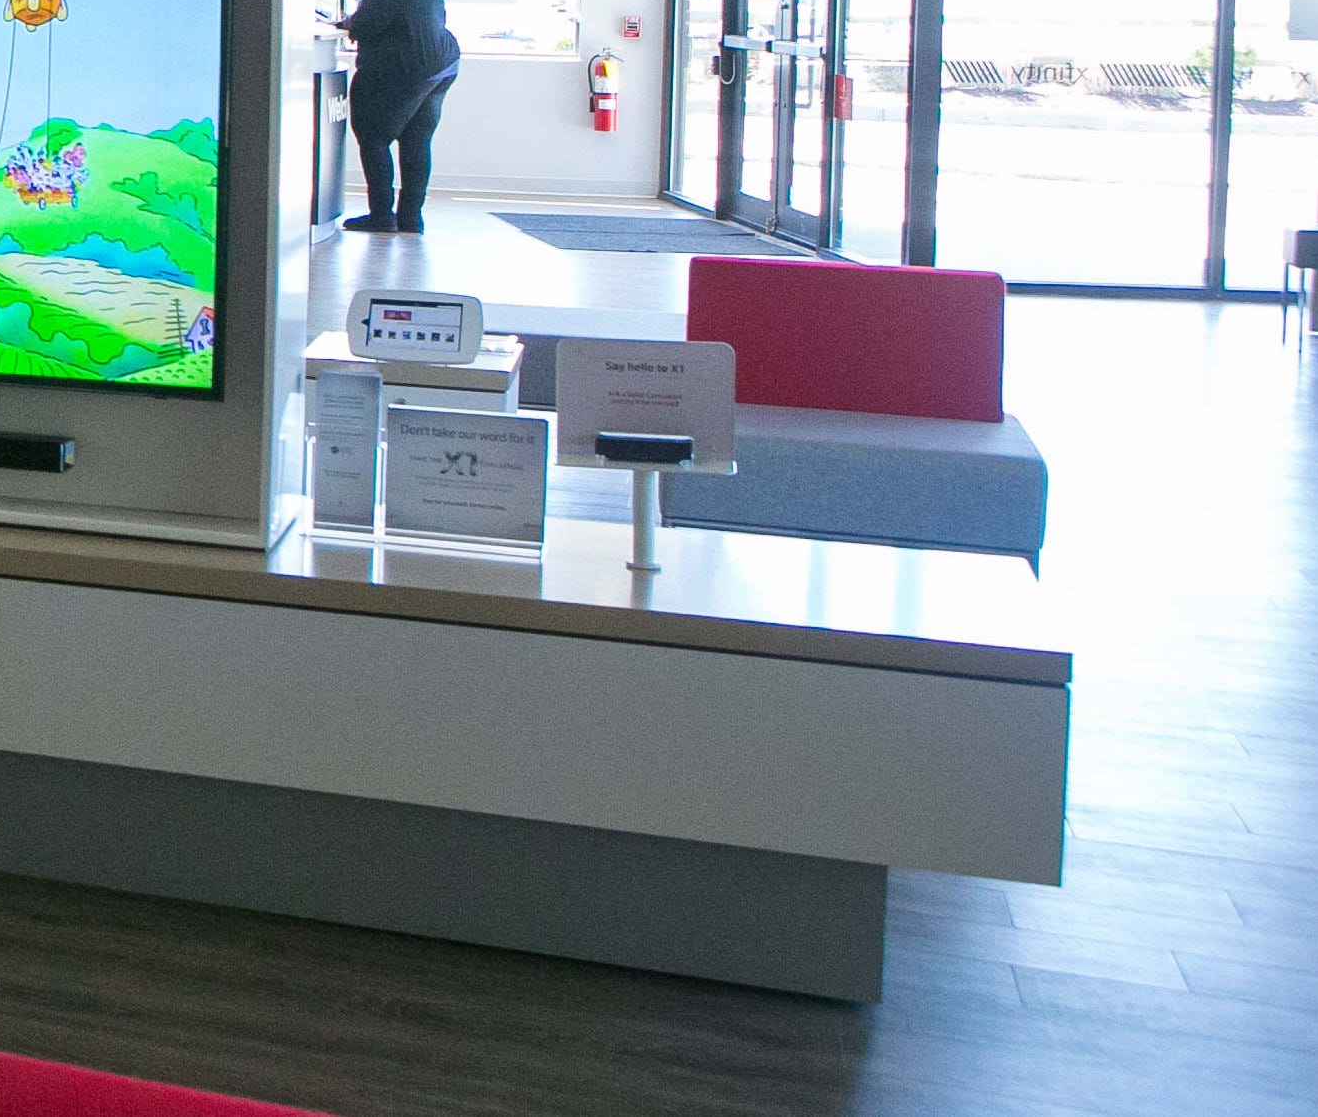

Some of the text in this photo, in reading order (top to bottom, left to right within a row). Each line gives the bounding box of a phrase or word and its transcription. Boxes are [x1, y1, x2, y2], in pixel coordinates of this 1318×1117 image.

[605, 362, 625, 373] Say
[627, 363, 654, 372] hello
[657, 364, 668, 373] to
[400, 423, 430, 436] Don't
[432, 426, 456, 439] take
[459, 430, 477, 439] our
[480, 431, 507, 443] word
[510, 433, 524, 444] for
